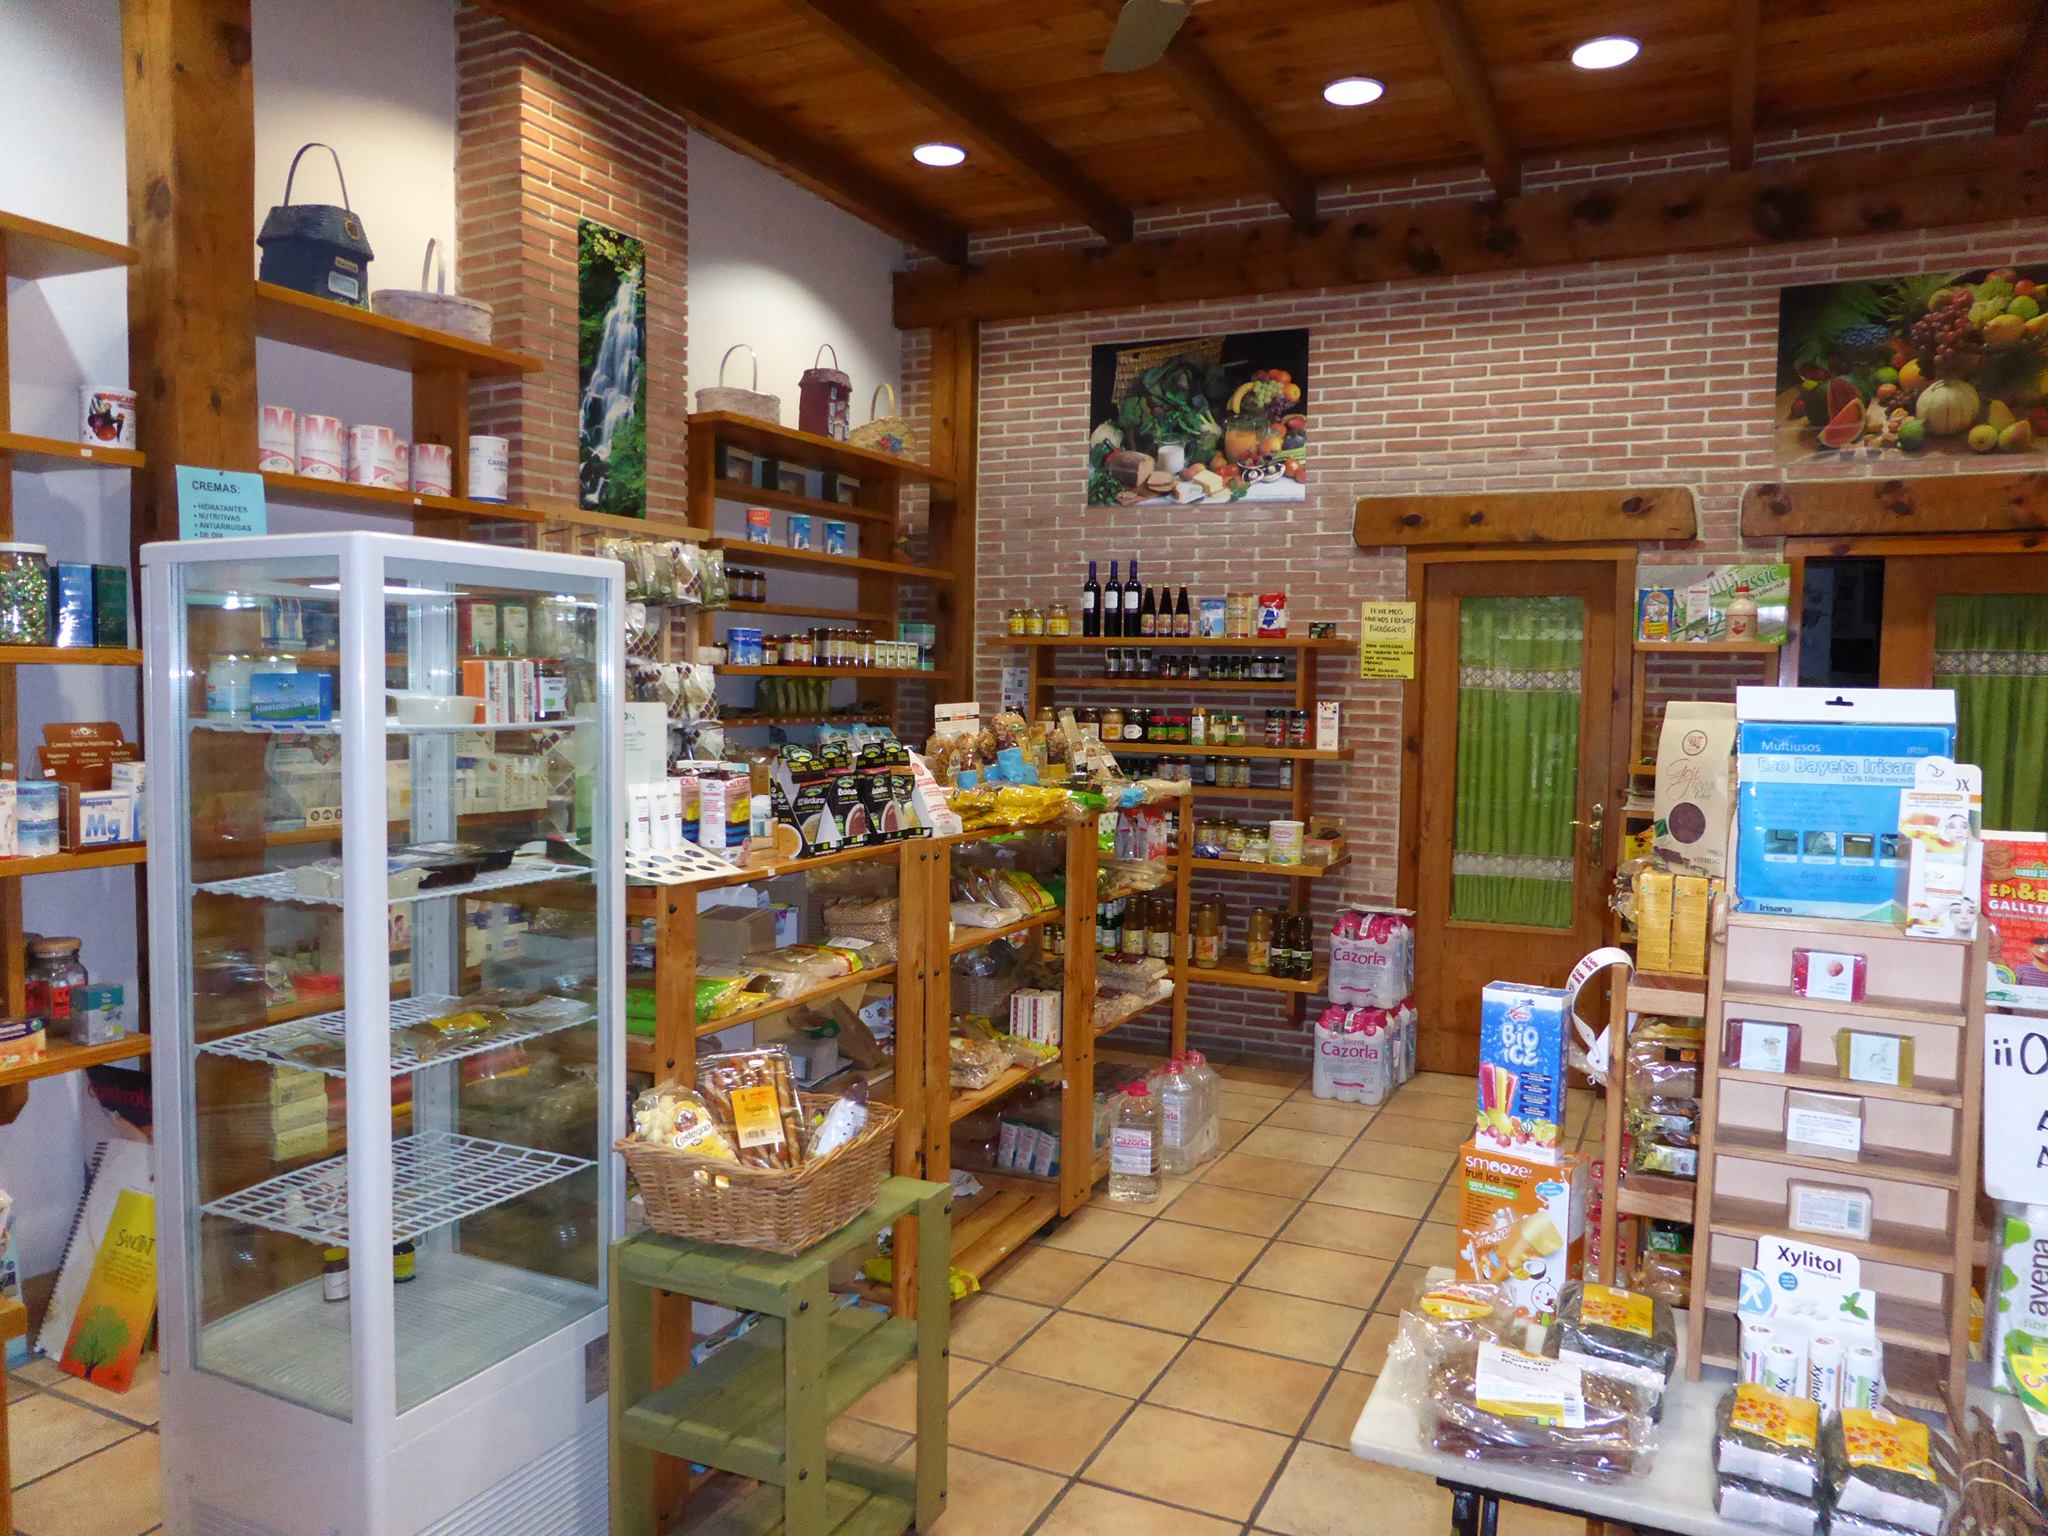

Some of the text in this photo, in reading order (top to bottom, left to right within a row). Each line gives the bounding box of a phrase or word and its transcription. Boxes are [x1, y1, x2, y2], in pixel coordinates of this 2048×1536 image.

[197, 503, 248, 513] HIDRATANTES
[198, 512, 240, 521] NUTRITIVAS
[199, 522, 252, 532] ANTIARRUGAS
[1761, 740, 1821, 753] Multiusos
[1758, 757, 1790, 773] Eco
[1794, 757, 1857, 776] Bayeta
[85, 814, 121, 841] Mg
[1759, 903, 1793, 914] Irisana
[1333, 947, 1386, 966] Cazorla
[1321, 1040, 1378, 1059] Cazorla
[1114, 1135, 1149, 1147] Cazorla
[1465, 1167, 1483, 1181] fruit
[1485, 1172, 1500, 1184] ice
[1777, 1244, 1842, 1274] Xylitol
[1811, 1364, 1824, 1403] Xylitol
